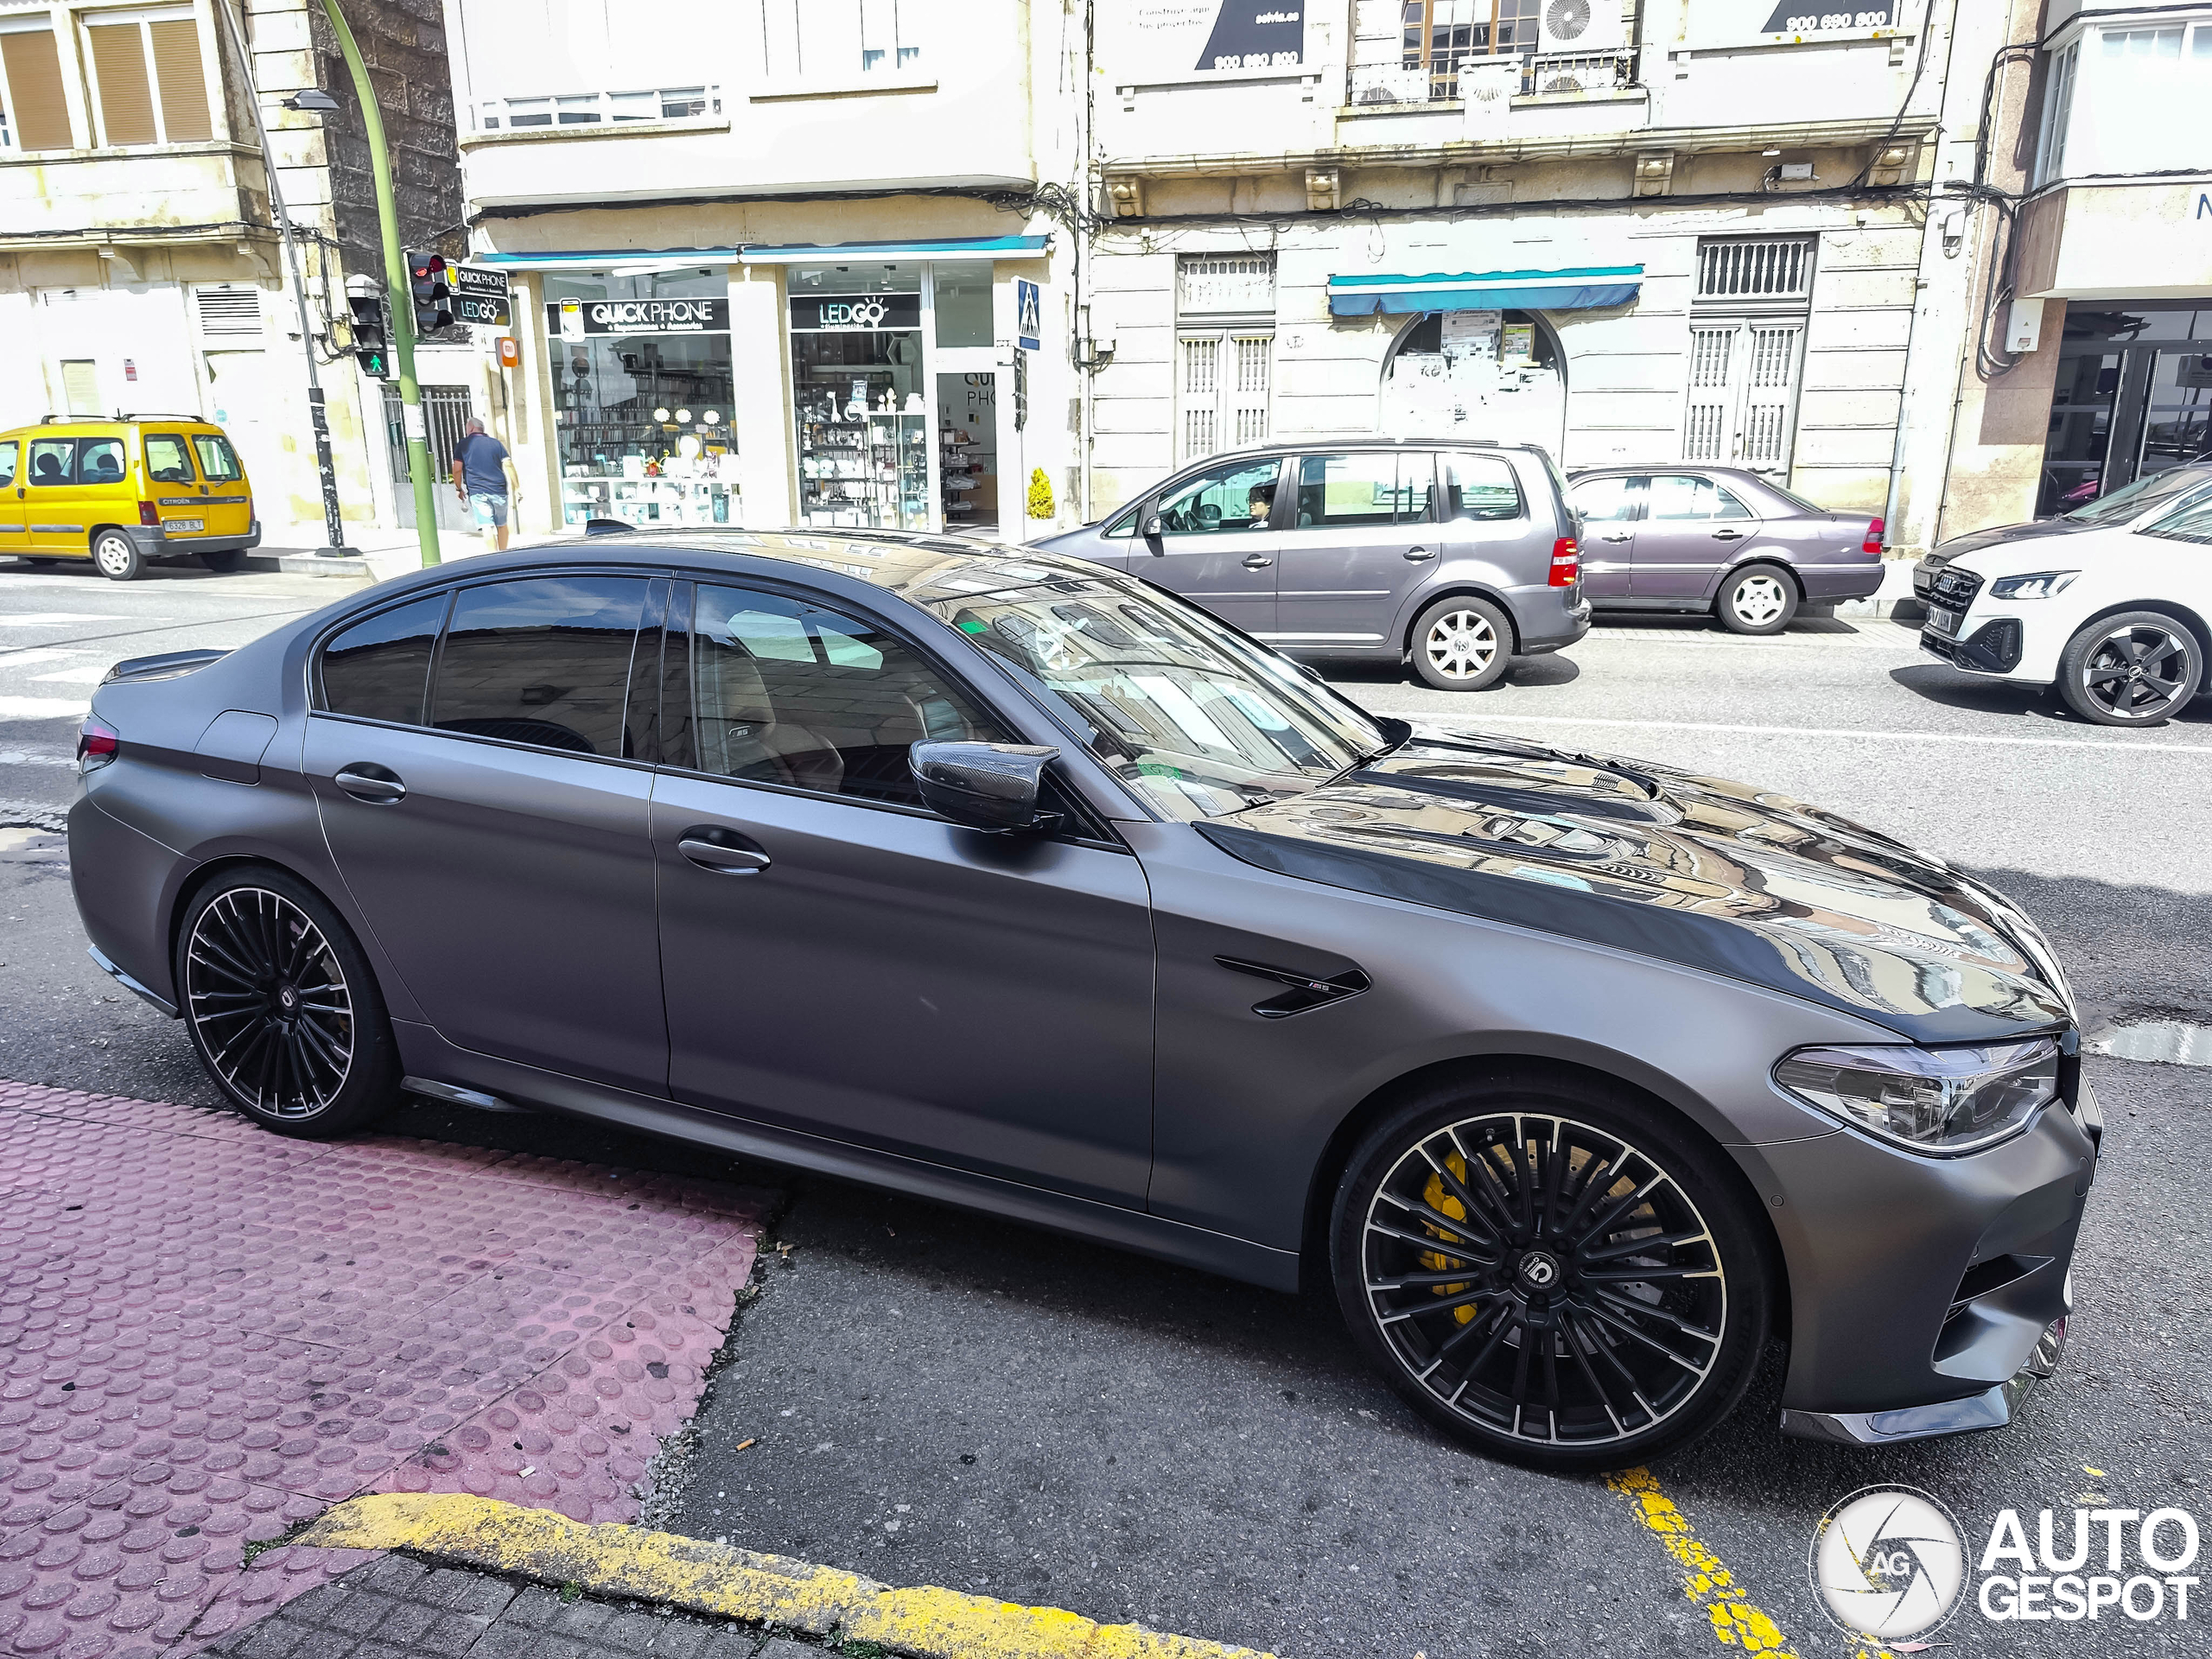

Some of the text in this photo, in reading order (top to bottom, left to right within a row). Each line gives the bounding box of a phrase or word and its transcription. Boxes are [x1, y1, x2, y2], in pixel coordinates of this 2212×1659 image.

[459, 270, 506, 287] QUICK PHONE
[591, 301, 714, 324] QUICK PHONE
[819, 302, 886, 328] LEDGO
[168, 520, 201, 531] 6328 BLT
